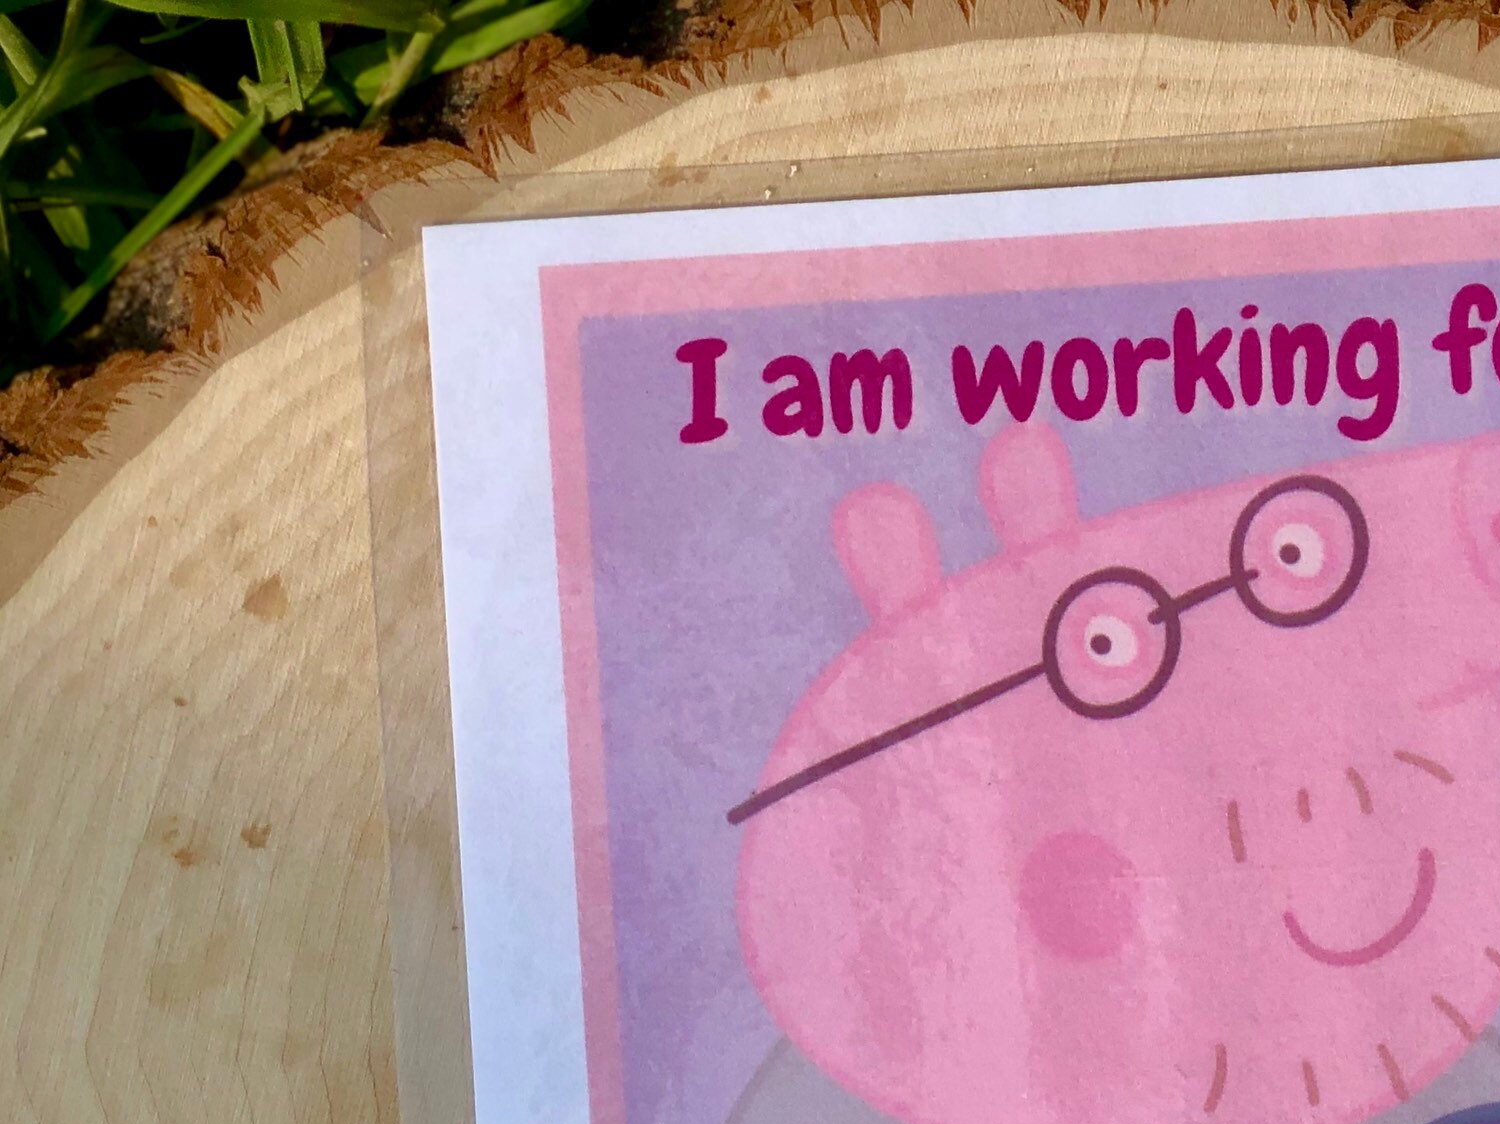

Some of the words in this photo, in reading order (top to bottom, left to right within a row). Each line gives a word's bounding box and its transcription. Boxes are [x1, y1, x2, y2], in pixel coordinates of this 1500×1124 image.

[675, 337, 729, 444] I
[761, 347, 913, 438] am
[951, 304, 1400, 442] working
